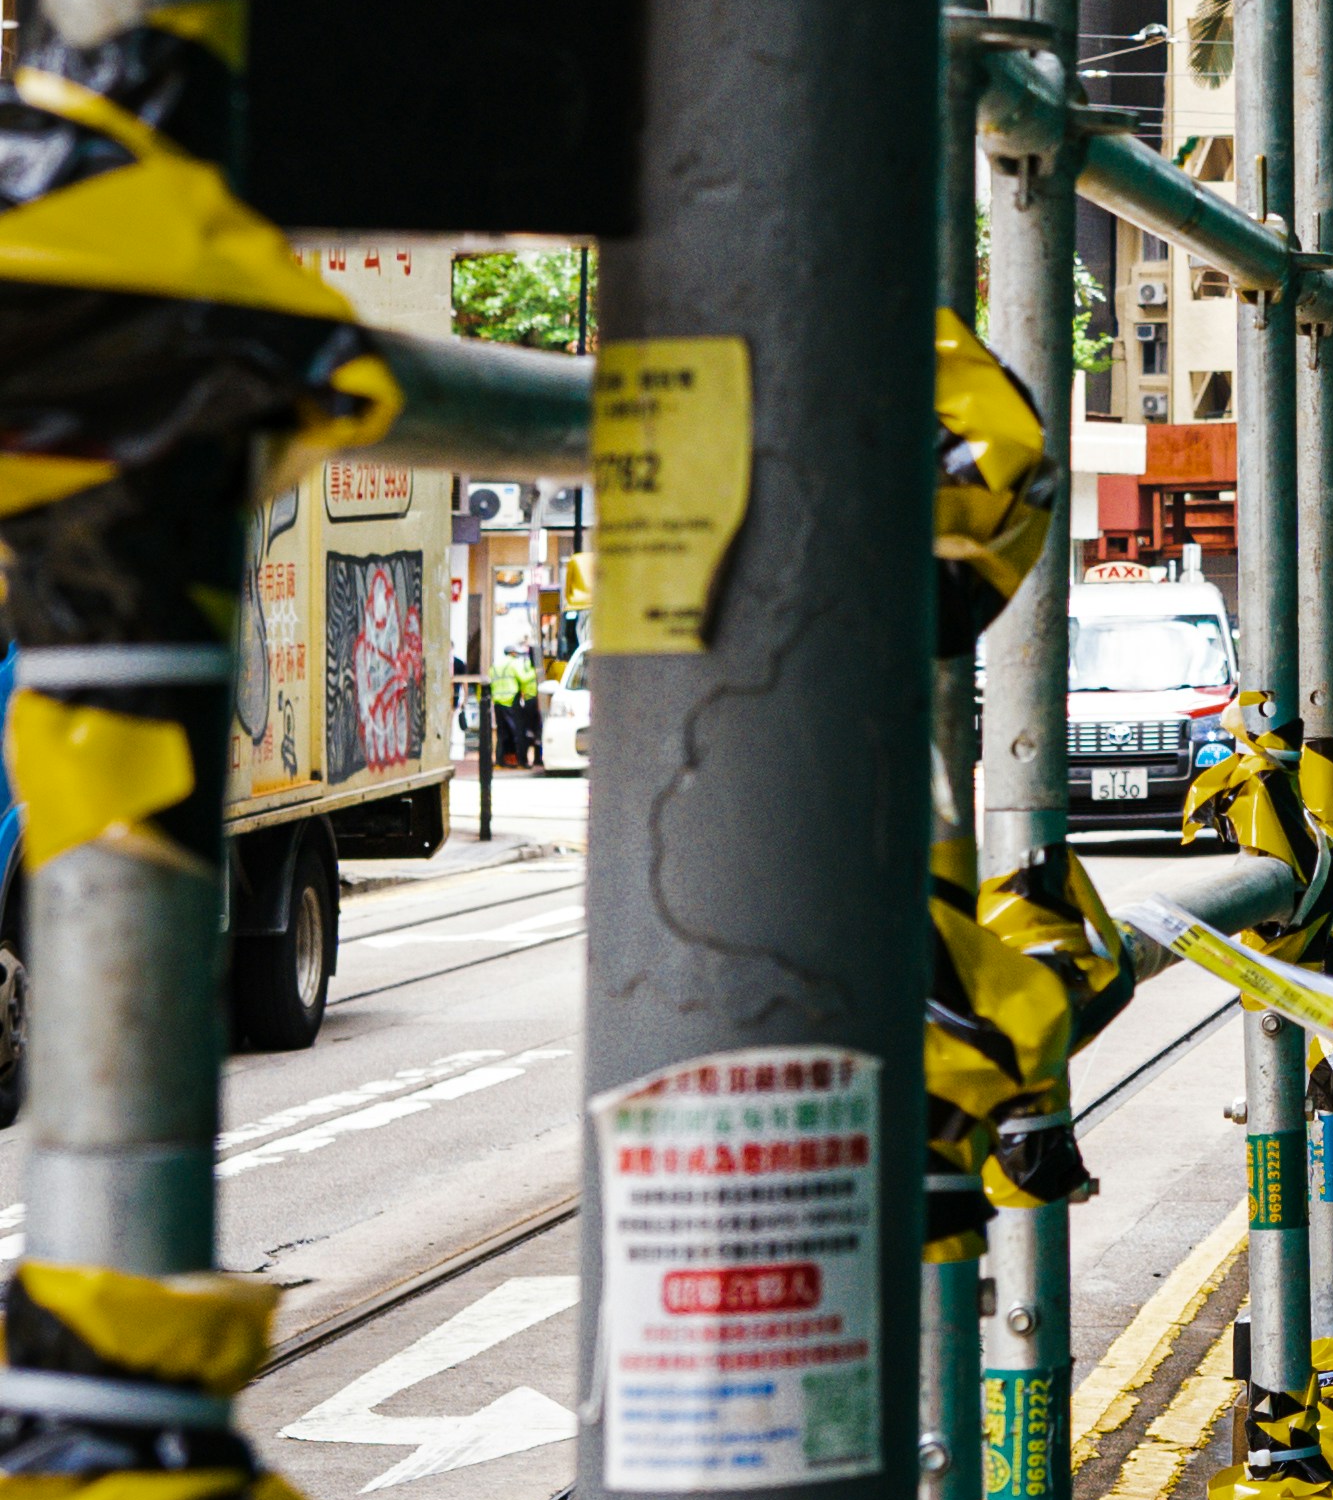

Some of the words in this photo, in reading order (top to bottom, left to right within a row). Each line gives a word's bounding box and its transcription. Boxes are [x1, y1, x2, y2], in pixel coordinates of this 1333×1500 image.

[1094, 566, 1144, 578] TAXI
[1266, 1140, 1281, 1180] 3222
[1268, 1183, 1283, 1222] 9698
[1028, 1378, 1050, 1435] 3222
[1026, 1439, 1047, 1497] 9698
